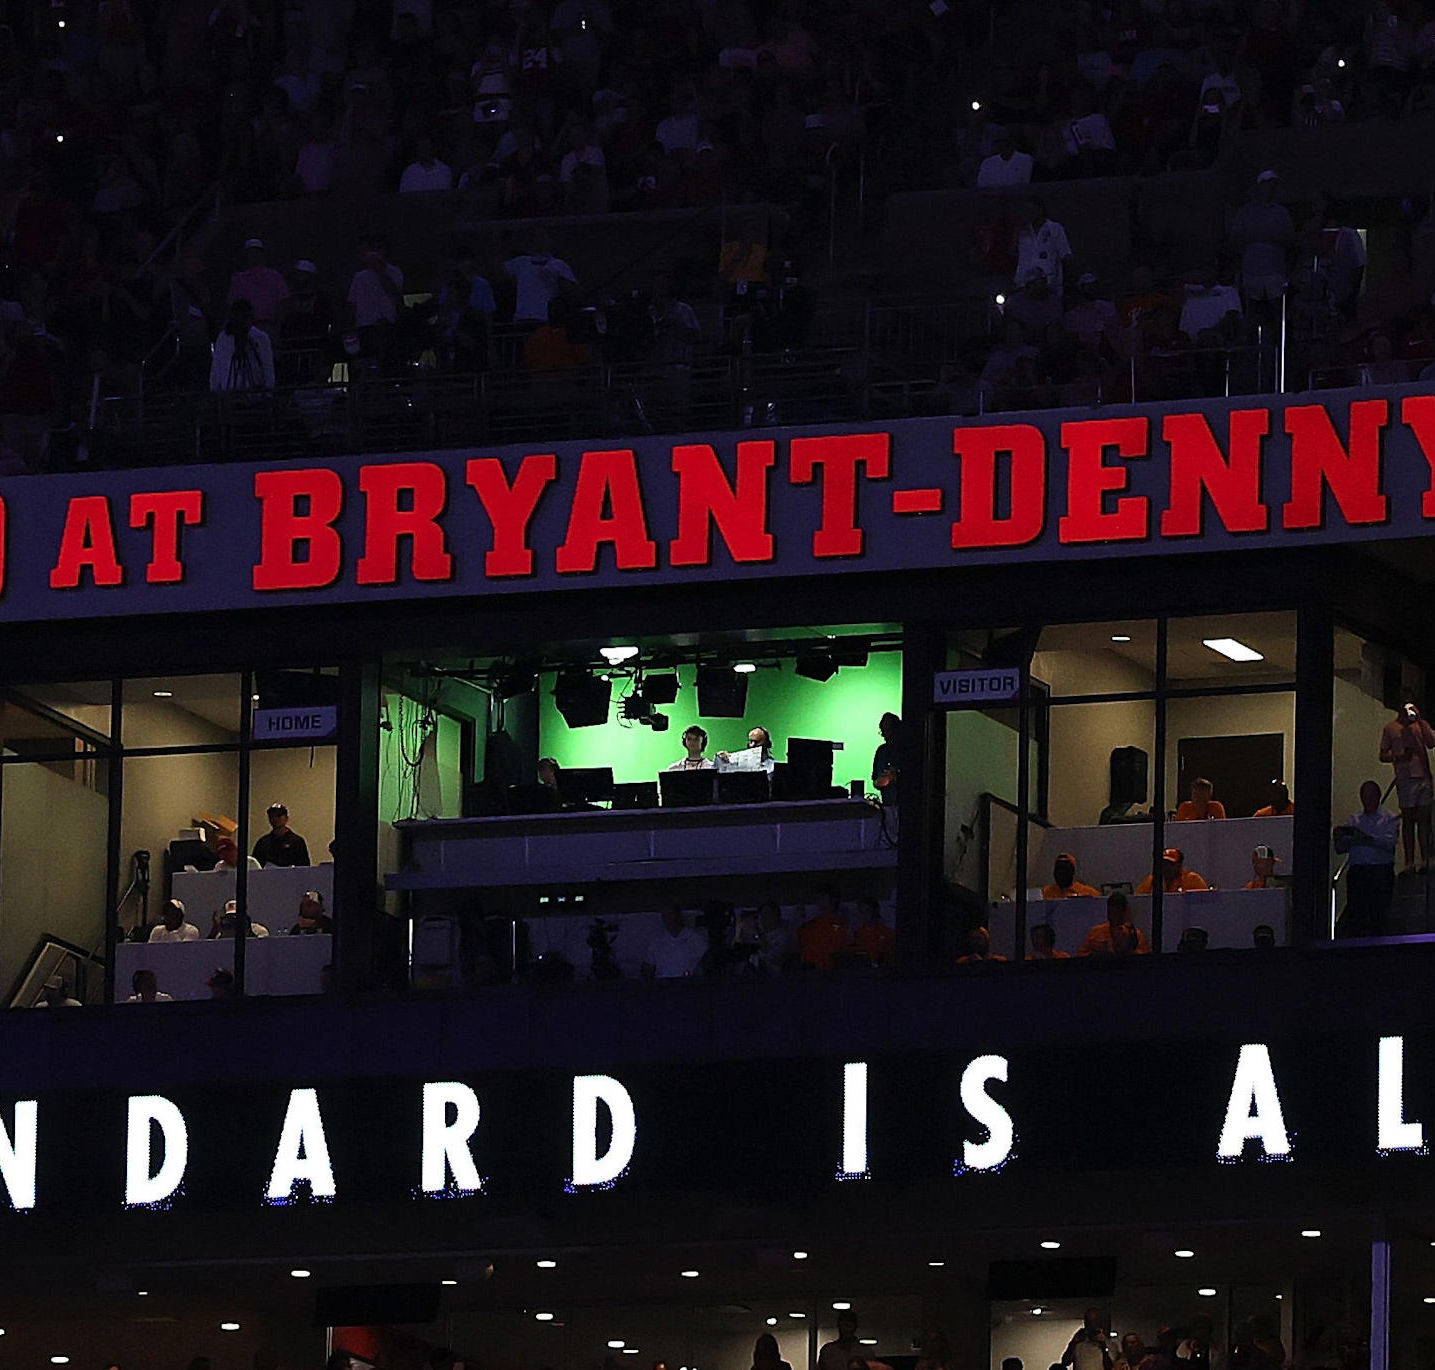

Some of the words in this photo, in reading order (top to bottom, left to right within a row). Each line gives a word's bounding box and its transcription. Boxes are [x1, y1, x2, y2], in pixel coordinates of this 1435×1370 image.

[49, 489, 203, 589] AT
[939, 676, 1015, 696] VISITOR
[268, 714, 322, 732] HOME
[841, 1053, 1015, 1178] IS
